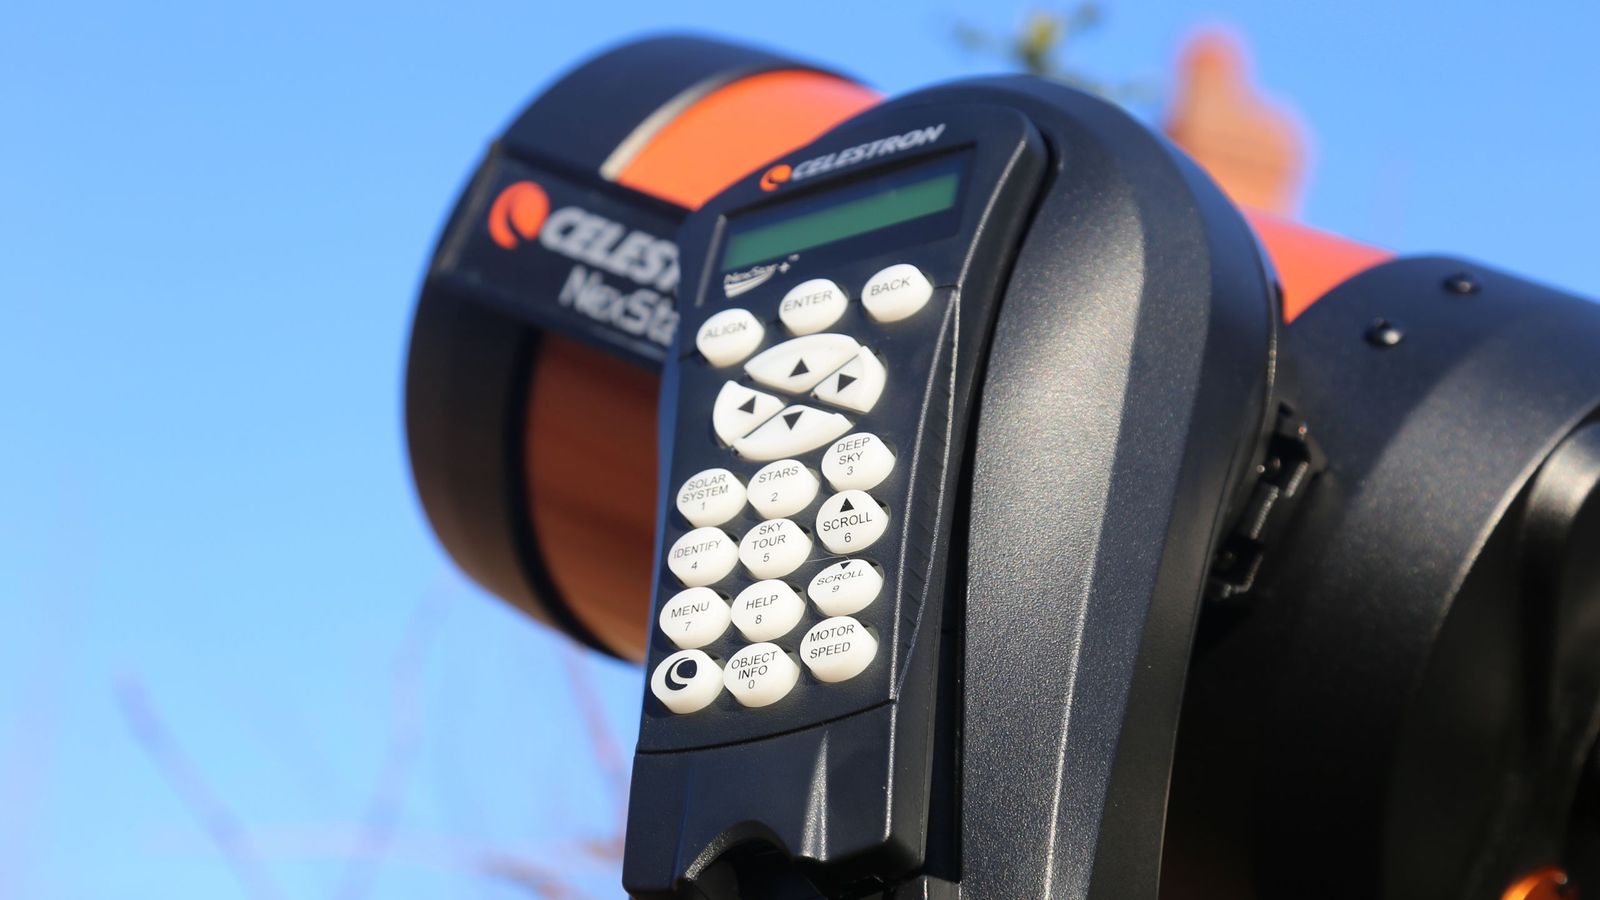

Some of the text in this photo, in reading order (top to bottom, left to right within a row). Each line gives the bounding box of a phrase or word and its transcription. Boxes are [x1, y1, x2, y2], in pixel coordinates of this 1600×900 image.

[790, 124, 946, 181] CELESTRON
[870, 275, 911, 297] BACK
[783, 289, 833, 312] ENTER
[703, 321, 748, 341] ALIGN
[836, 436, 871, 453] DEEP
[838, 451, 864, 465] SKY
[758, 466, 799, 483] STARS
[846, 466, 854, 476] 3
[687, 473, 727, 490] SOLAR
[681, 484, 729, 503] SYSTEM
[771, 492, 779, 502] 2
[701, 502, 706, 510] 1
[759, 521, 785, 535] SKY
[823, 511, 873, 532] SCROLL
[752, 534, 786, 550] TOUR
[844, 532, 852, 543] 6
[673, 539, 722, 559] IDENTIFY
[691, 560, 698, 570] 4
[763, 552, 770, 563] 5
[816, 568, 864, 586] SCROLL
[831, 584, 840, 593] 9
[670, 601, 710, 618] MENU
[745, 594, 779, 610] HELP
[684, 621, 692, 632] 7
[755, 614, 762, 624] 8
[809, 624, 855, 642] MOTOR
[809, 641, 851, 659] SPEED
[730, 650, 778, 670] OBJECT
[737, 665, 768, 680] INFO
[748, 679, 755, 689] 0
